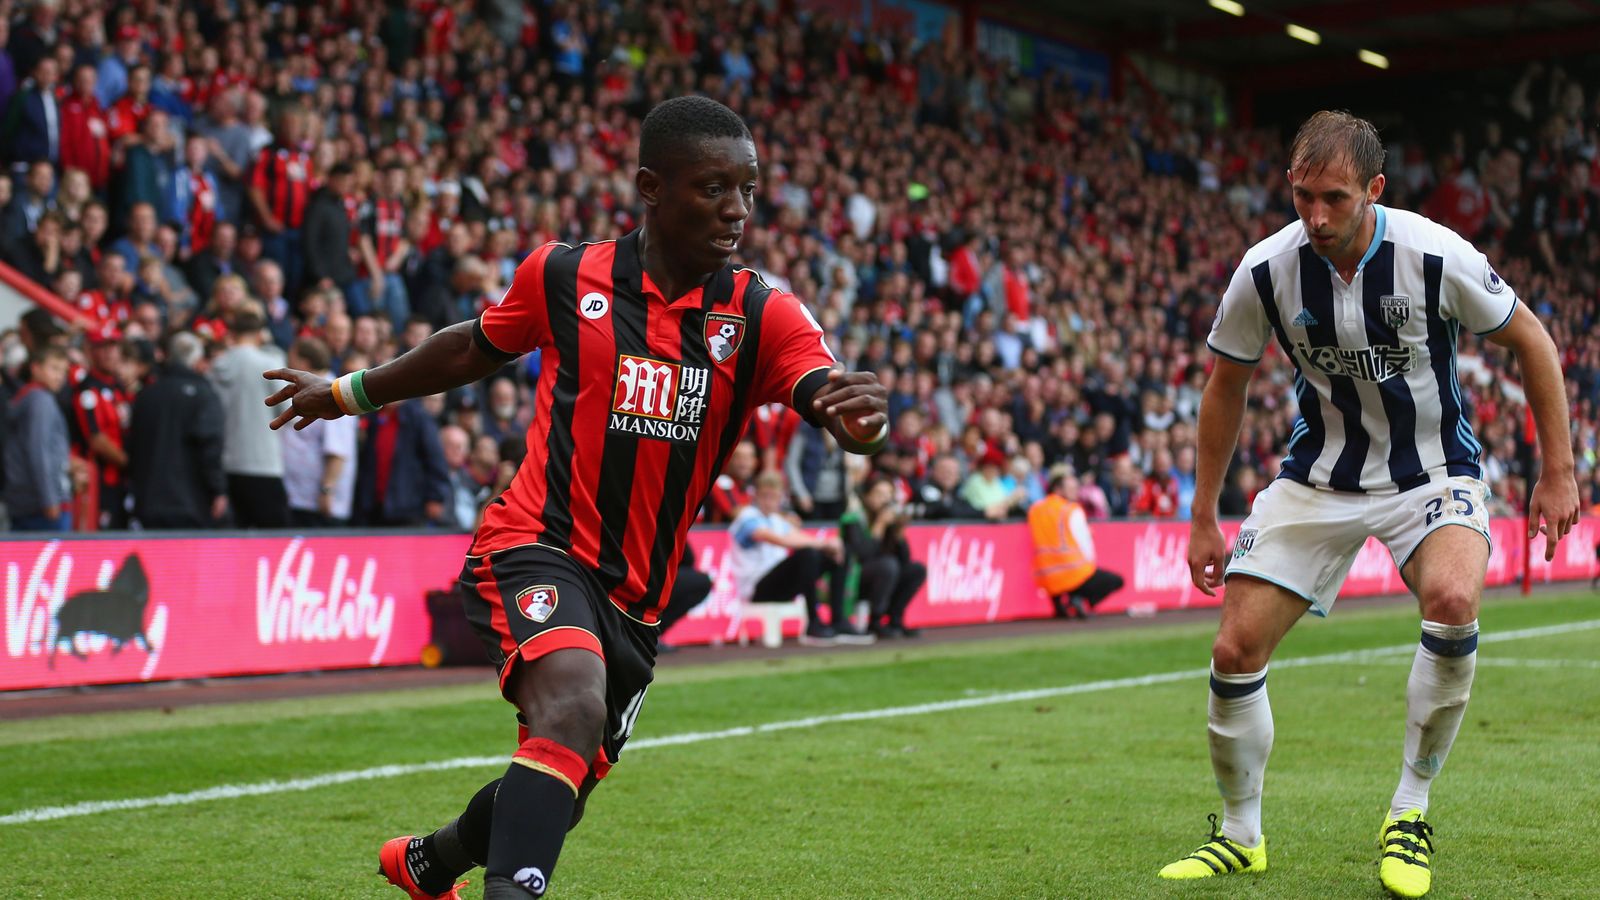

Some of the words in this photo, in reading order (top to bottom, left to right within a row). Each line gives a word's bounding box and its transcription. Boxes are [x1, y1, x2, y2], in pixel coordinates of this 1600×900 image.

[585, 300, 604, 312] JD
[609, 414, 701, 441] MANSION
[1425, 488, 1474, 527] 25
[256, 535, 395, 665] Vitality
